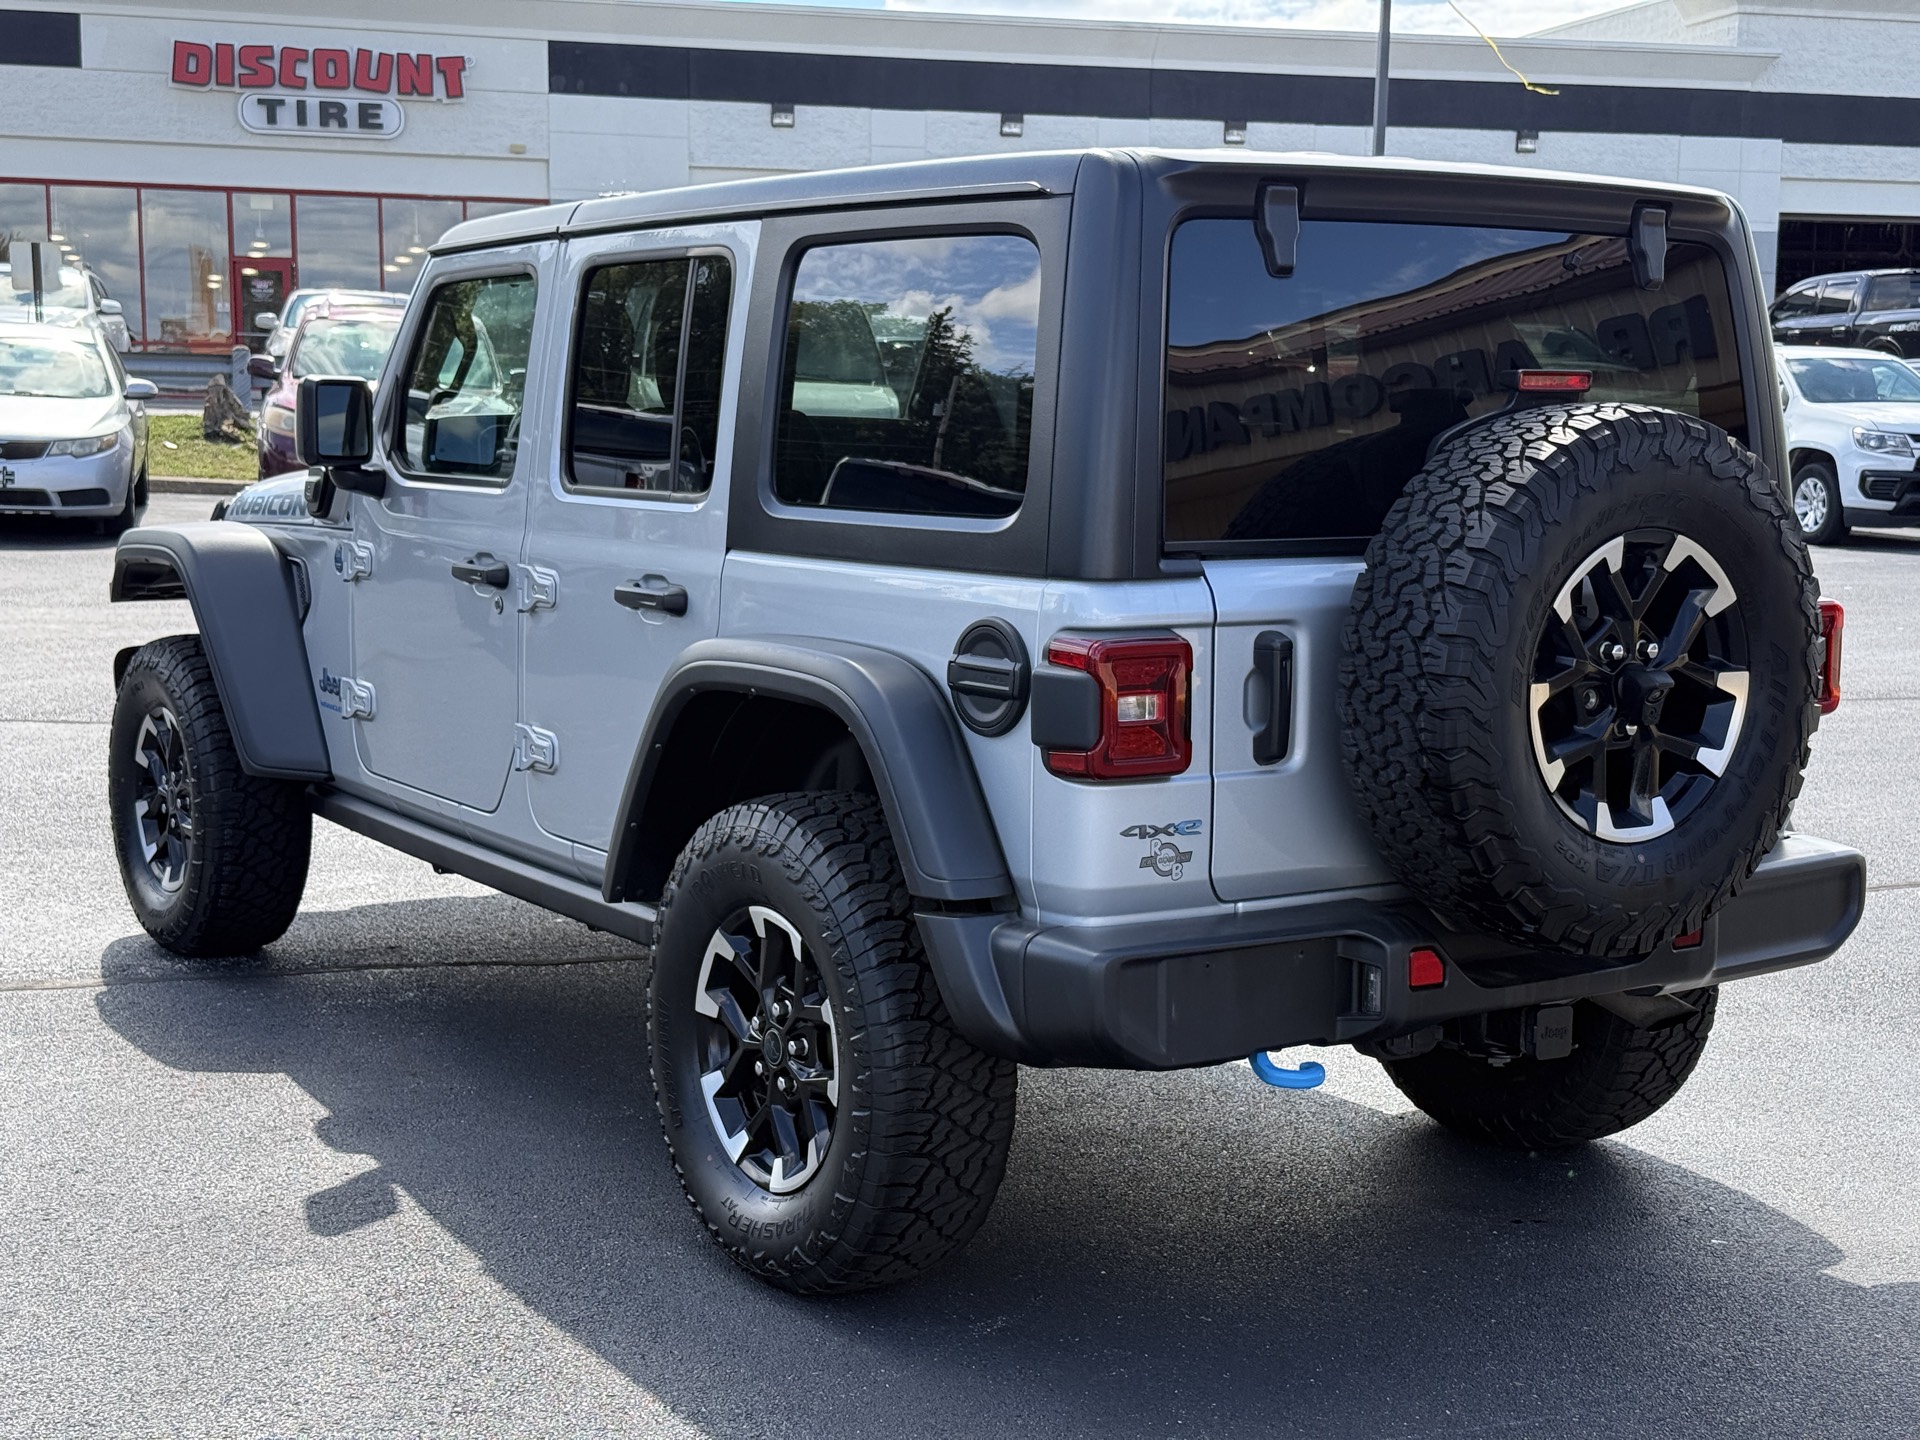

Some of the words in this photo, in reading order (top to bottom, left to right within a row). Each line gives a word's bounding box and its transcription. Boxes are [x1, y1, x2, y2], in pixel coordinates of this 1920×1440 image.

[171, 39, 466, 99] DISCOUNT
[256, 97, 384, 131] TIRE
[1541, 1026, 1567, 1040] Jeep
[728, 1202, 815, 1242] THRASHER
